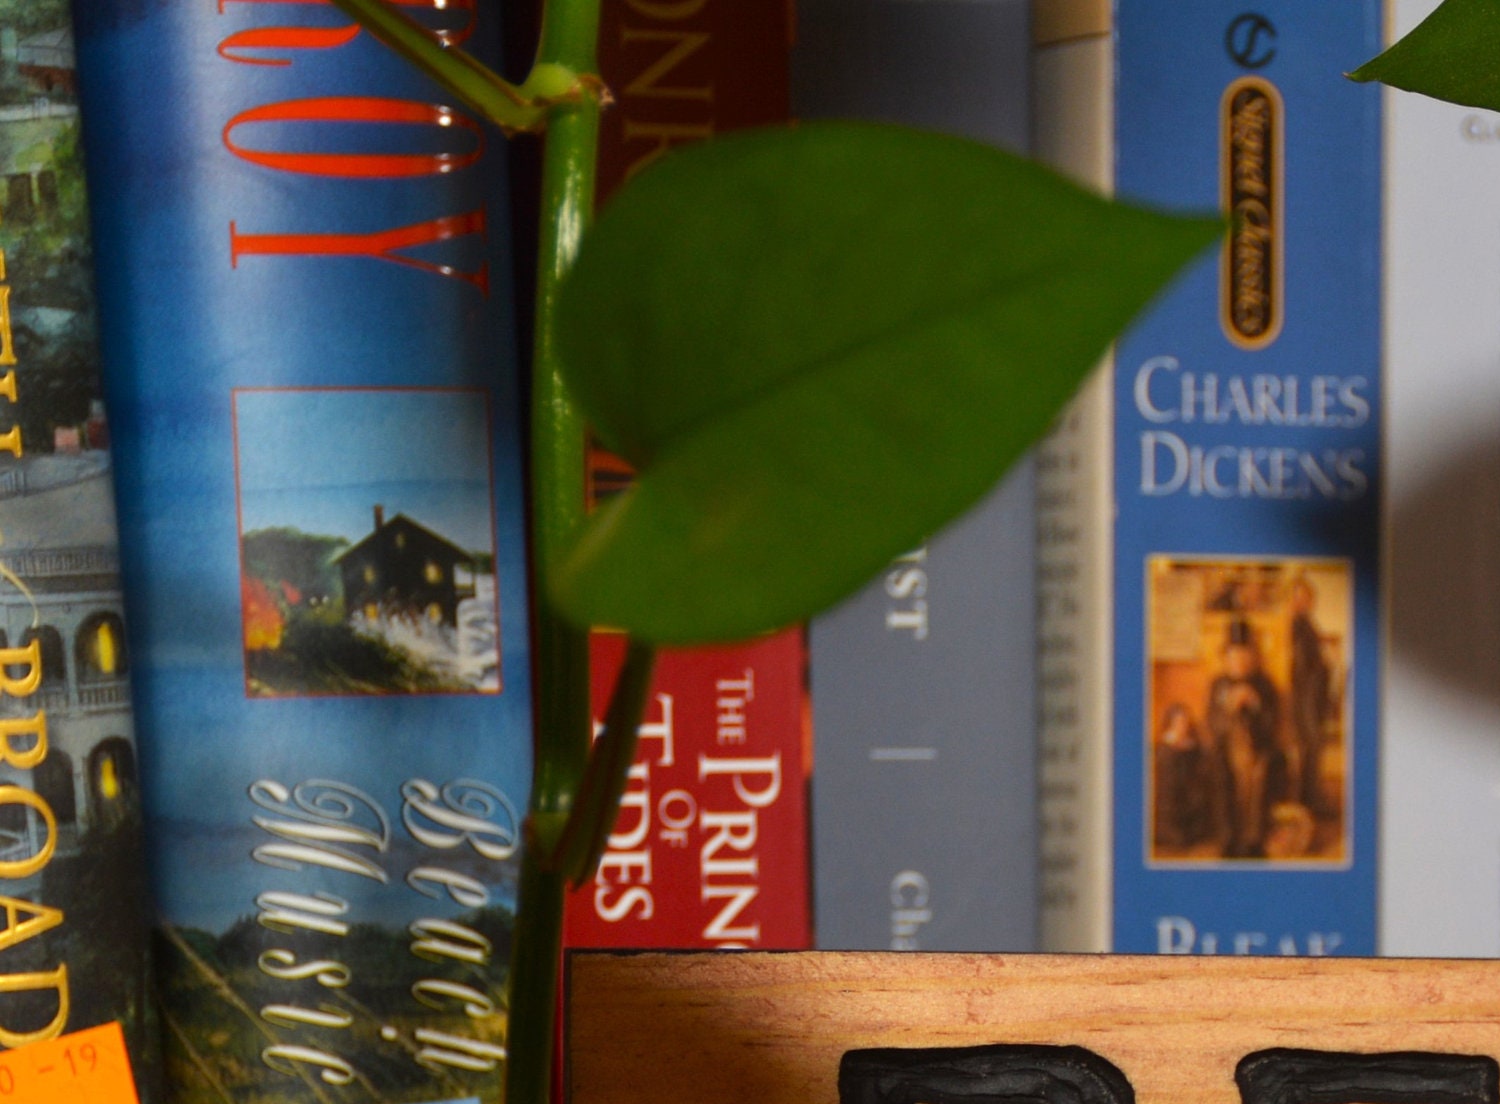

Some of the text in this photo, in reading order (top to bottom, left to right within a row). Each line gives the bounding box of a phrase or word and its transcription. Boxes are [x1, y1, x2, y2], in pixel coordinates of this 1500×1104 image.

[1134, 355, 1370, 428] CHARLES
[1140, 430, 1369, 500] DICKENS
[658, 789, 697, 848] OF
[698, 667, 782, 949] THE PRIN
[250, 778, 397, 1085] Music
[403, 778, 518, 1072] Beach
